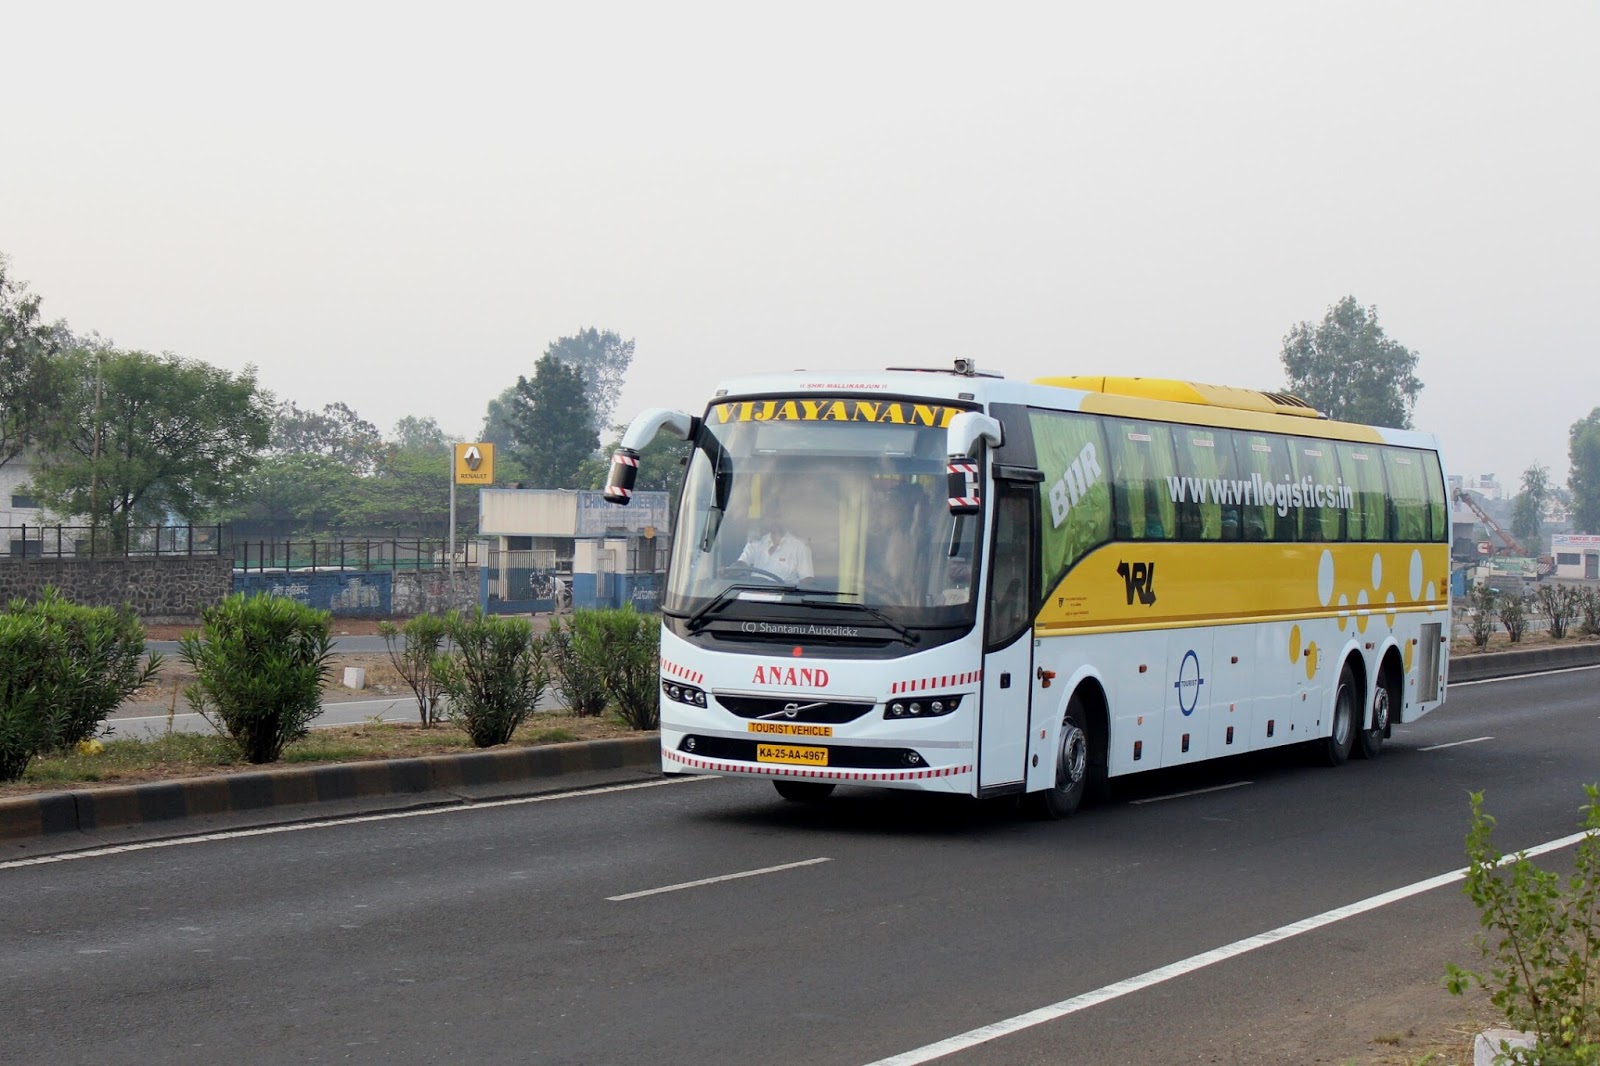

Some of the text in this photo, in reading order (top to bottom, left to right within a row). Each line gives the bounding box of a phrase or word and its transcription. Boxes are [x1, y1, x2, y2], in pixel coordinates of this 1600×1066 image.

[1049, 441, 1102, 529] B11R
[1166, 473, 1354, 517] www.vrllogistics.in
[752, 665, 829, 688] ANAND
[1181, 679, 1198, 688] TOURIST
[751, 723, 831, 737] TOURIST VEHICLE
[759, 748, 825, 761] KA-25-AA-4967
